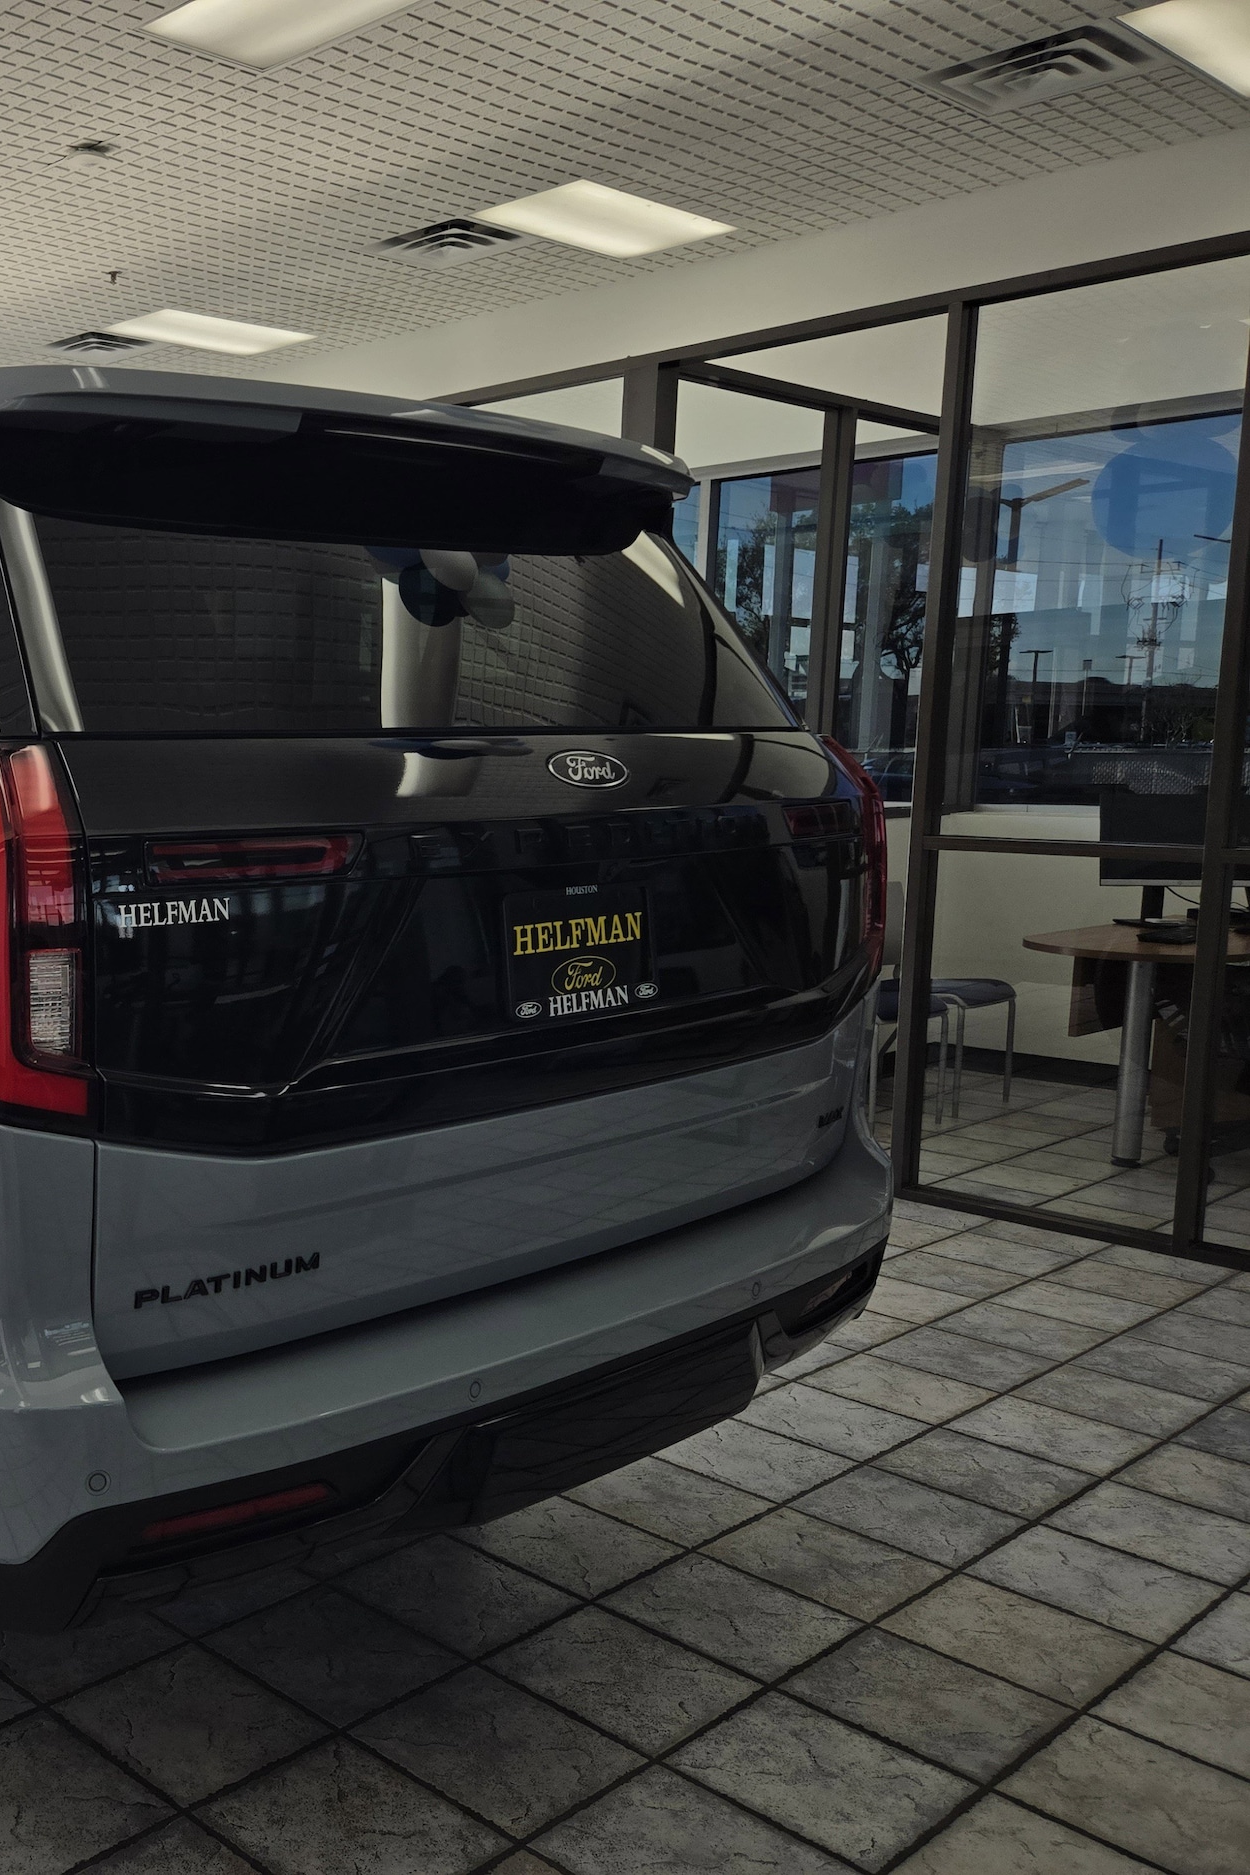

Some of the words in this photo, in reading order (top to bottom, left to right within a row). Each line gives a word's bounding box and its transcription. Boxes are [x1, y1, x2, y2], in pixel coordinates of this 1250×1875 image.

[566, 755, 616, 781] Ford
[407, 812, 763, 861] EXPEDITIO
[565, 884, 599, 896] HOUSTON
[118, 897, 231, 928] HELFMAN
[513, 911, 643, 956] HELFMAN
[564, 960, 604, 991] Ford
[548, 984, 630, 1017] HELFMAN
[133, 1251, 321, 1309] PLATINUM
